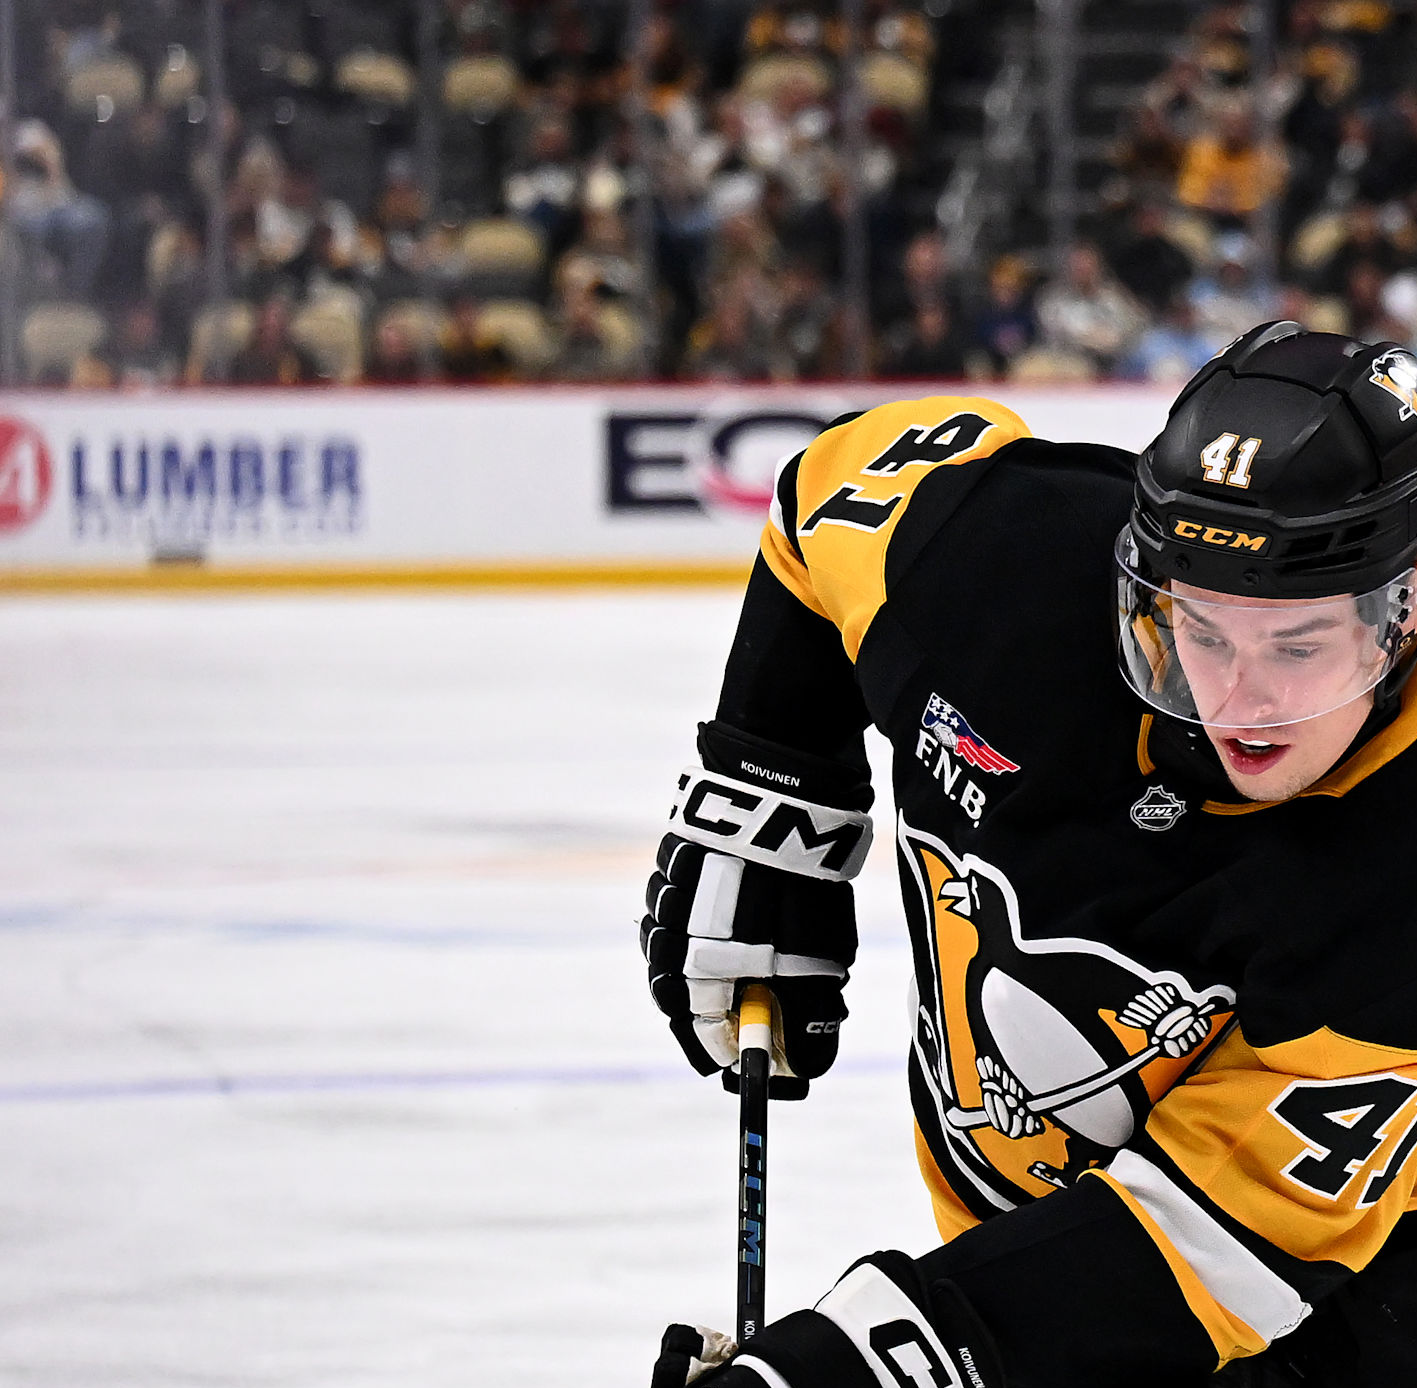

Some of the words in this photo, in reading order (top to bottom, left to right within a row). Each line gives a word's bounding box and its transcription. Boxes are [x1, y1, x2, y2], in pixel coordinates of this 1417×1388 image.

[68, 434, 364, 510] LUMBER
[797, 412, 998, 536] 41
[1201, 431, 1262, 489] 41
[1173, 520, 1267, 551] CCM
[740, 760, 800, 788] KOIVUNEN
[915, 729, 986, 829] F.N.B.
[669, 773, 866, 873] CM
[1138, 807, 1173, 817] NHL
